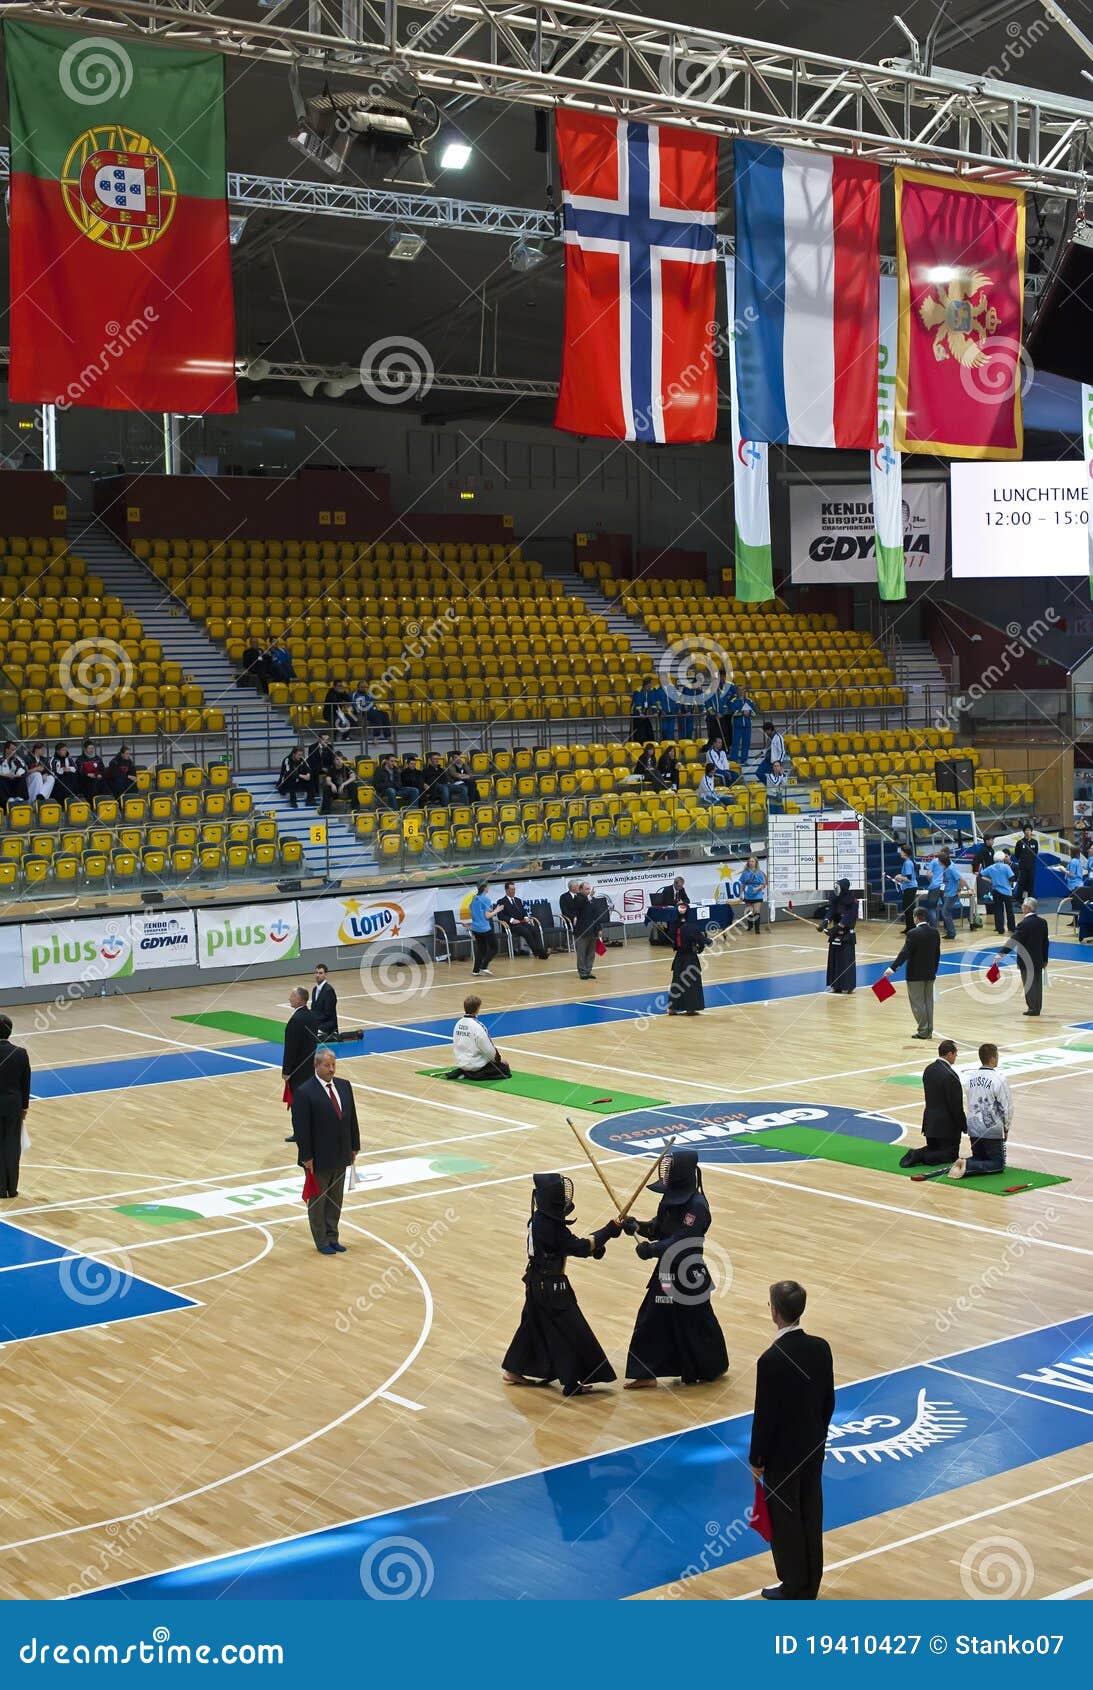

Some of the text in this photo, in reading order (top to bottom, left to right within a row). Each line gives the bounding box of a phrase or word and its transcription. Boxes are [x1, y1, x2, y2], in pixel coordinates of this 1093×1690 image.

[993, 487, 1088, 501] LUNCHTIME
[985, 511, 1031, 525] 12:00
[808, 534, 931, 562] GDYIA
[315, 832, 321, 842] 5
[407, 825, 414, 835] 6
[350, 909, 392, 937] LOTTO
[140, 934, 189, 950] GDYNIA
[207, 919, 266, 957] plus
[32, 935, 97, 974] plus
[969, 1075, 993, 1090] RUSSIA
[624, 1106, 827, 1150] GDYNIA
[223, 1183, 304, 1207] plu
